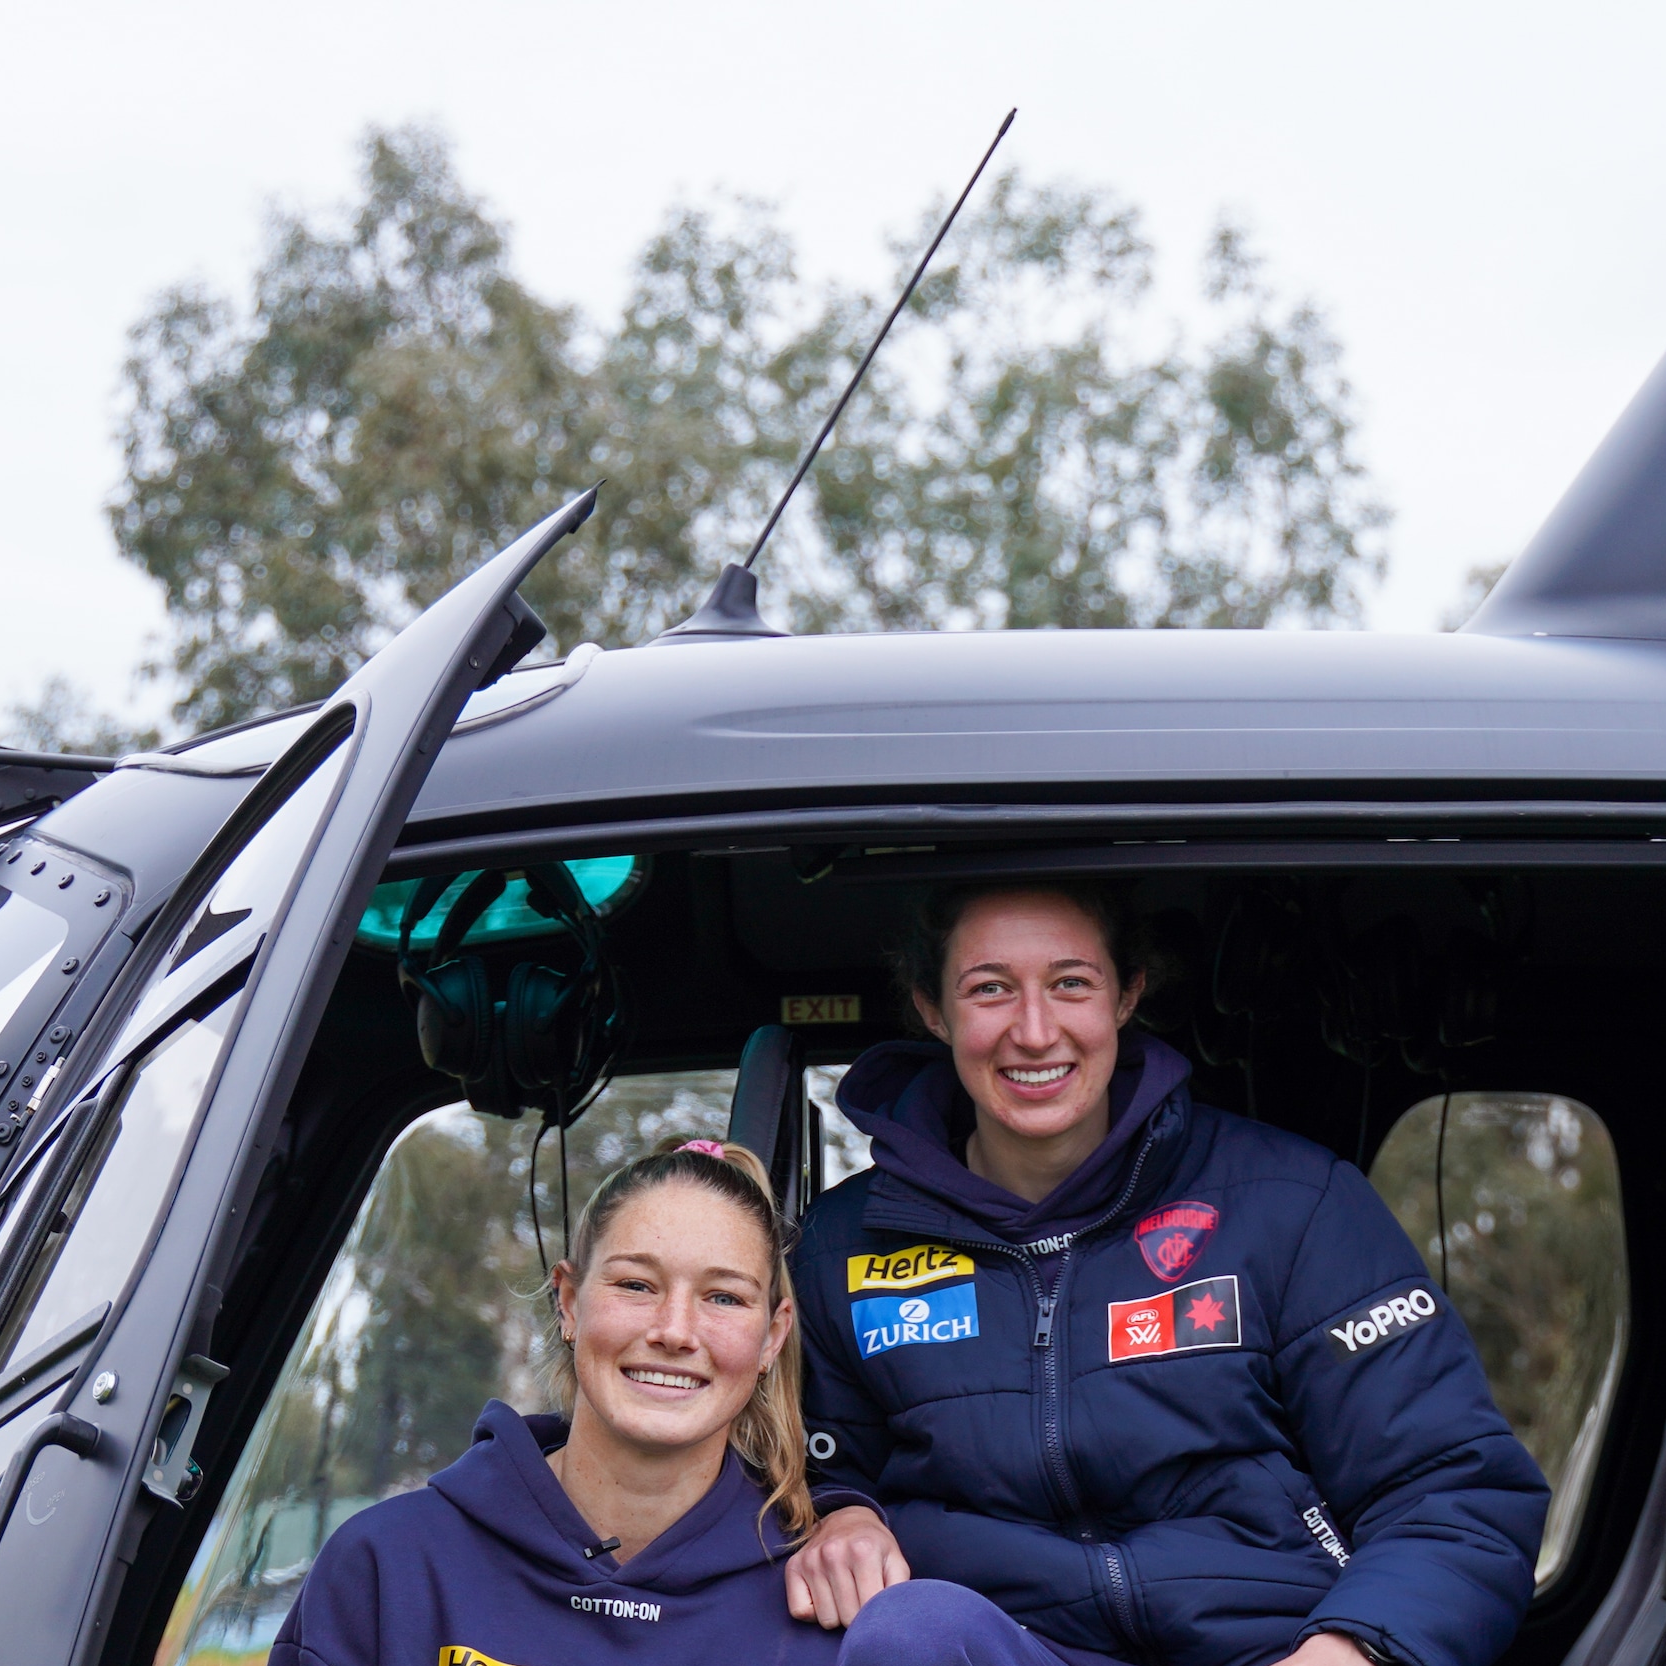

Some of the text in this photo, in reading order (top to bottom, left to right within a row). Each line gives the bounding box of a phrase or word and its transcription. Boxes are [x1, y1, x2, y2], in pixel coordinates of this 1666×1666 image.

[788, 998, 853, 1020] EXIT
[1138, 1208, 1214, 1236] MELBOURNE
[864, 1246, 961, 1280] Hertz
[863, 1315, 972, 1354] ZURICH
[1330, 1288, 1436, 1352] YoPRO
[570, 1595, 661, 1622] COTTON:ON
